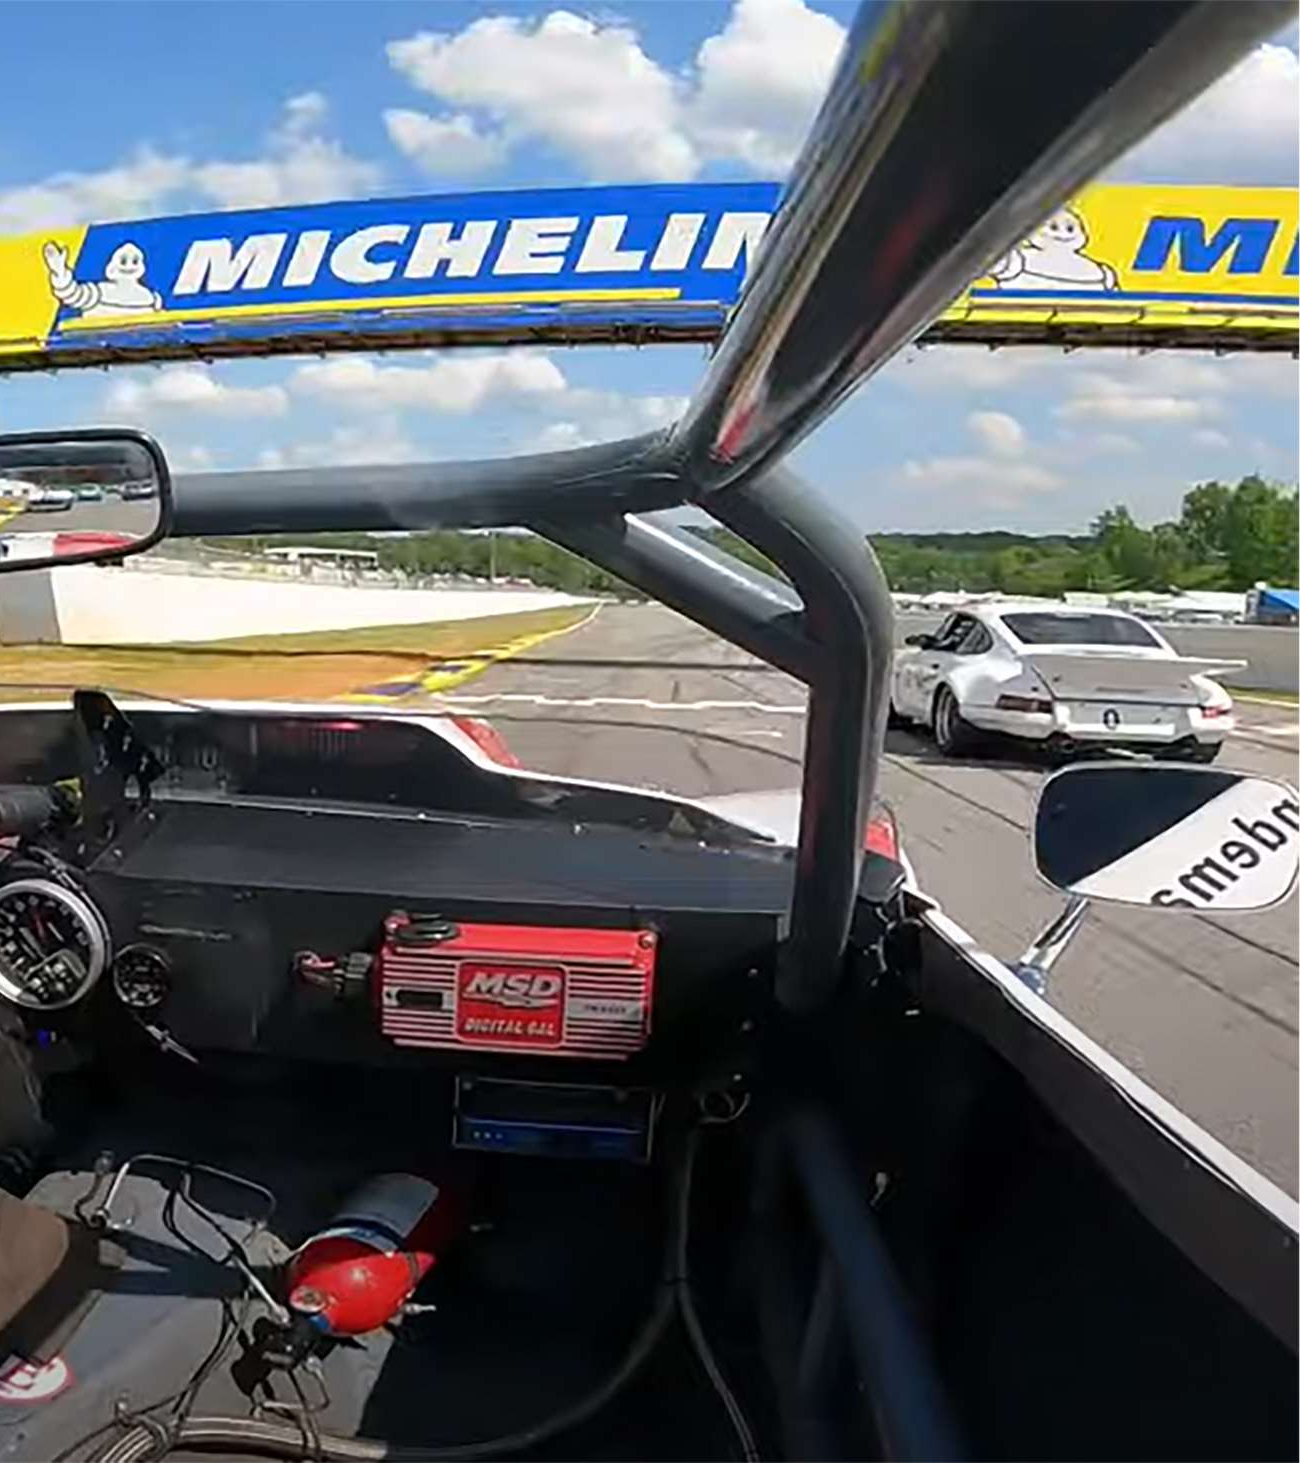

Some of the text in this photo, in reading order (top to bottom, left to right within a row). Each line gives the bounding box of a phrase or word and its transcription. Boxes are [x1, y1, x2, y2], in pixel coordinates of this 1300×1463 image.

[172, 211, 772, 296] MICHELIN
[465, 971, 563, 998] MSD
[464, 1017, 523, 1035] DIGITAL
